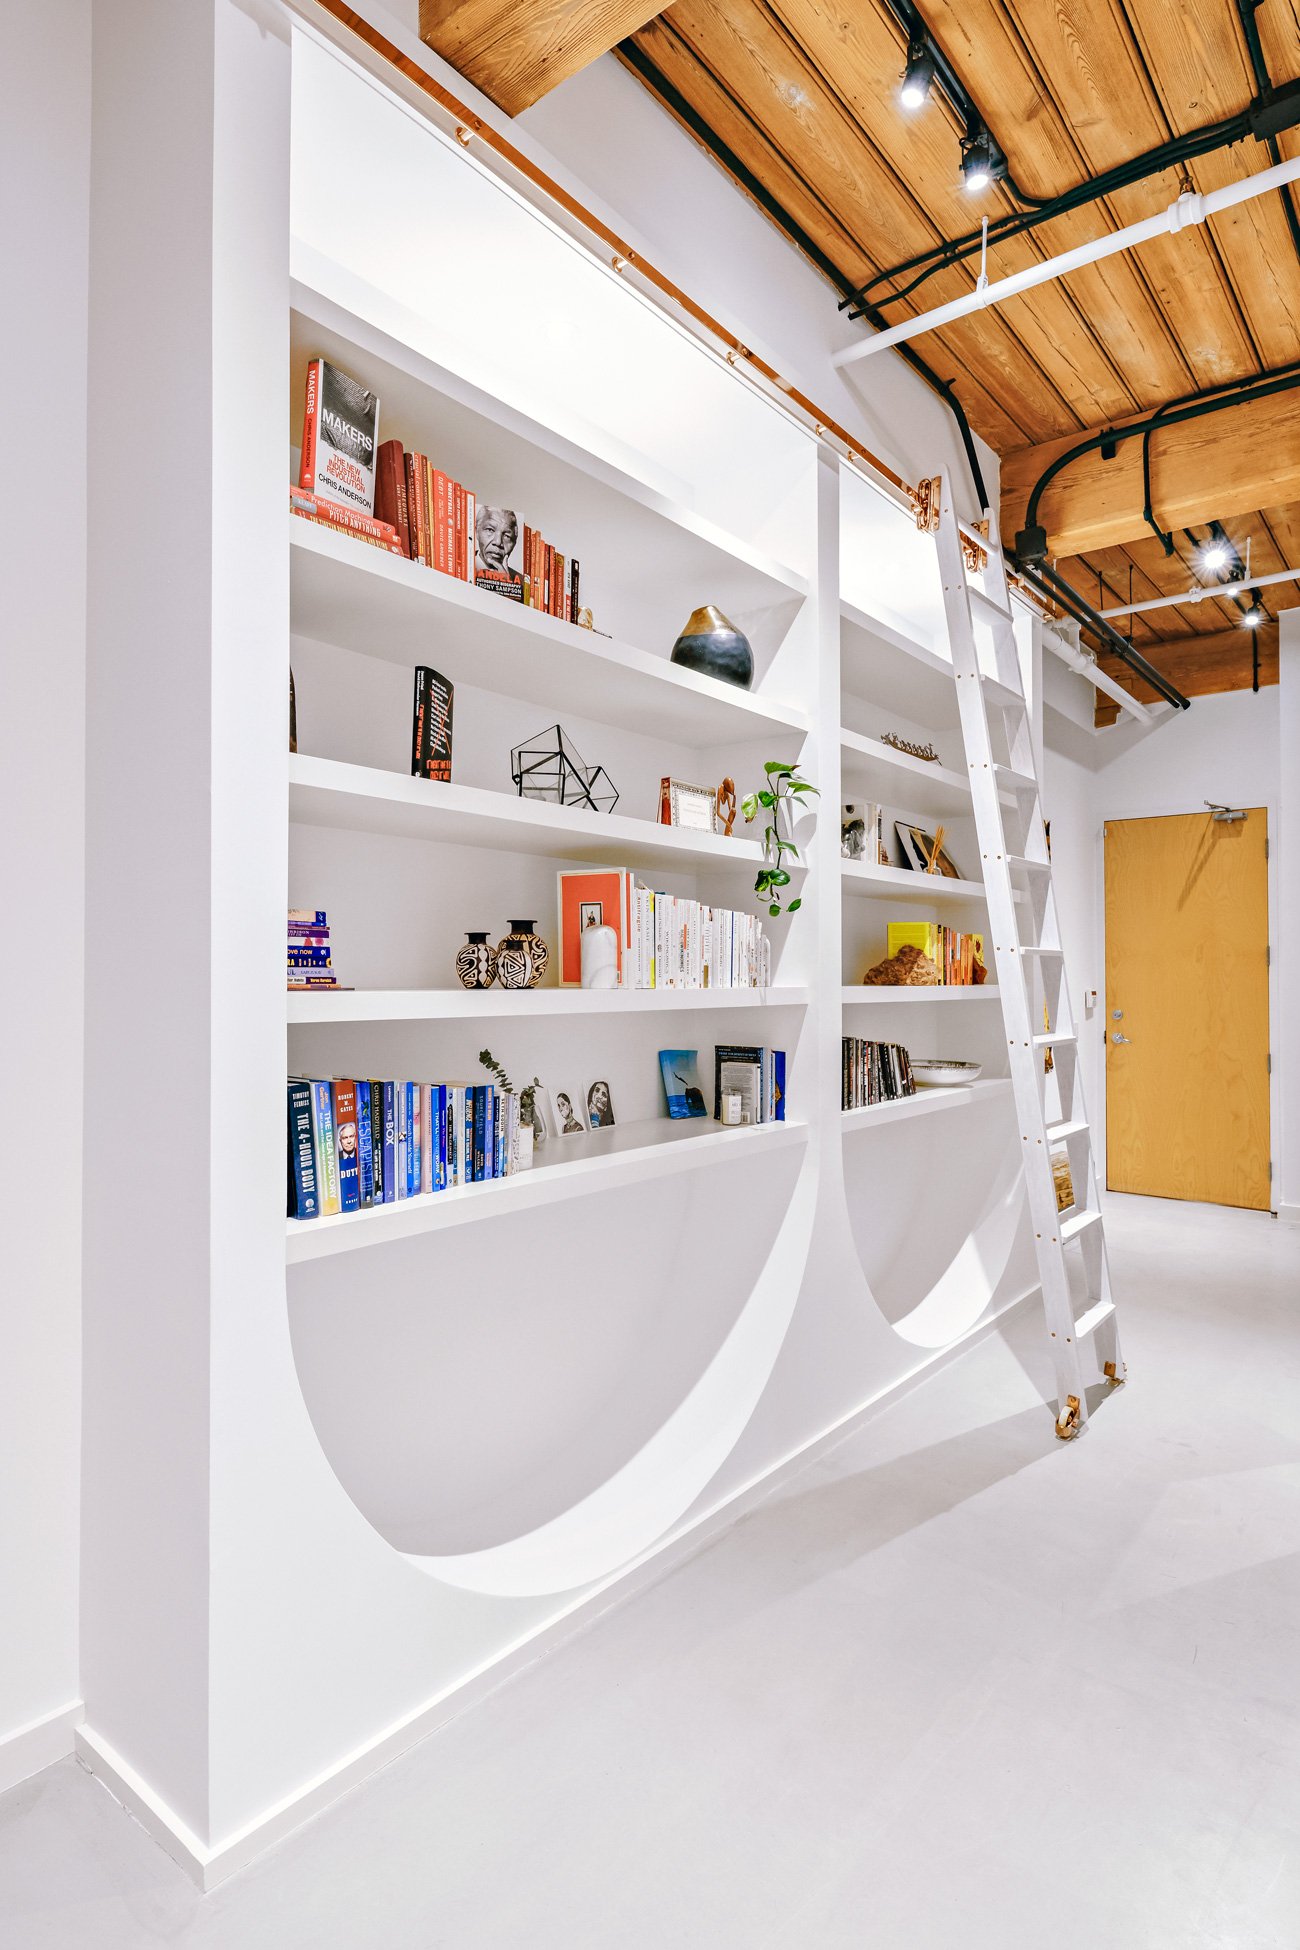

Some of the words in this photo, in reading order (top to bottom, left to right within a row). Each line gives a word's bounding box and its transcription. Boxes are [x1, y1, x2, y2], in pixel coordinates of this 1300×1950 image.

[307, 370, 316, 414] MAKERS
[322, 408, 372, 450] MAKERS
[328, 459, 364, 486] INDUSTRIAL
[333, 454, 345, 467] THE
[347, 462, 360, 475] NEW
[318, 474, 337, 490] CHRIS
[338, 485, 372, 509] ANDERSON
[326, 465, 365, 494] REVOLUTION
[311, 496, 342, 513] Prediction
[345, 510, 373, 526] Machines
[330, 510, 348, 524] PITCH
[350, 518, 381, 538] ANYTHING
[476, 582, 494, 590] THONY
[496, 585, 522, 594] SAMPSON
[477, 569, 520, 585] ANDELA
[297, 1113, 309, 1131] THE
[386, 1121, 394, 1145] BOX
[299, 1134, 312, 1168] 4-HOUR
[324, 1110, 332, 1130] THE
[328, 1156, 337, 1198] FACTORY
[301, 1169, 315, 1192] BODY
